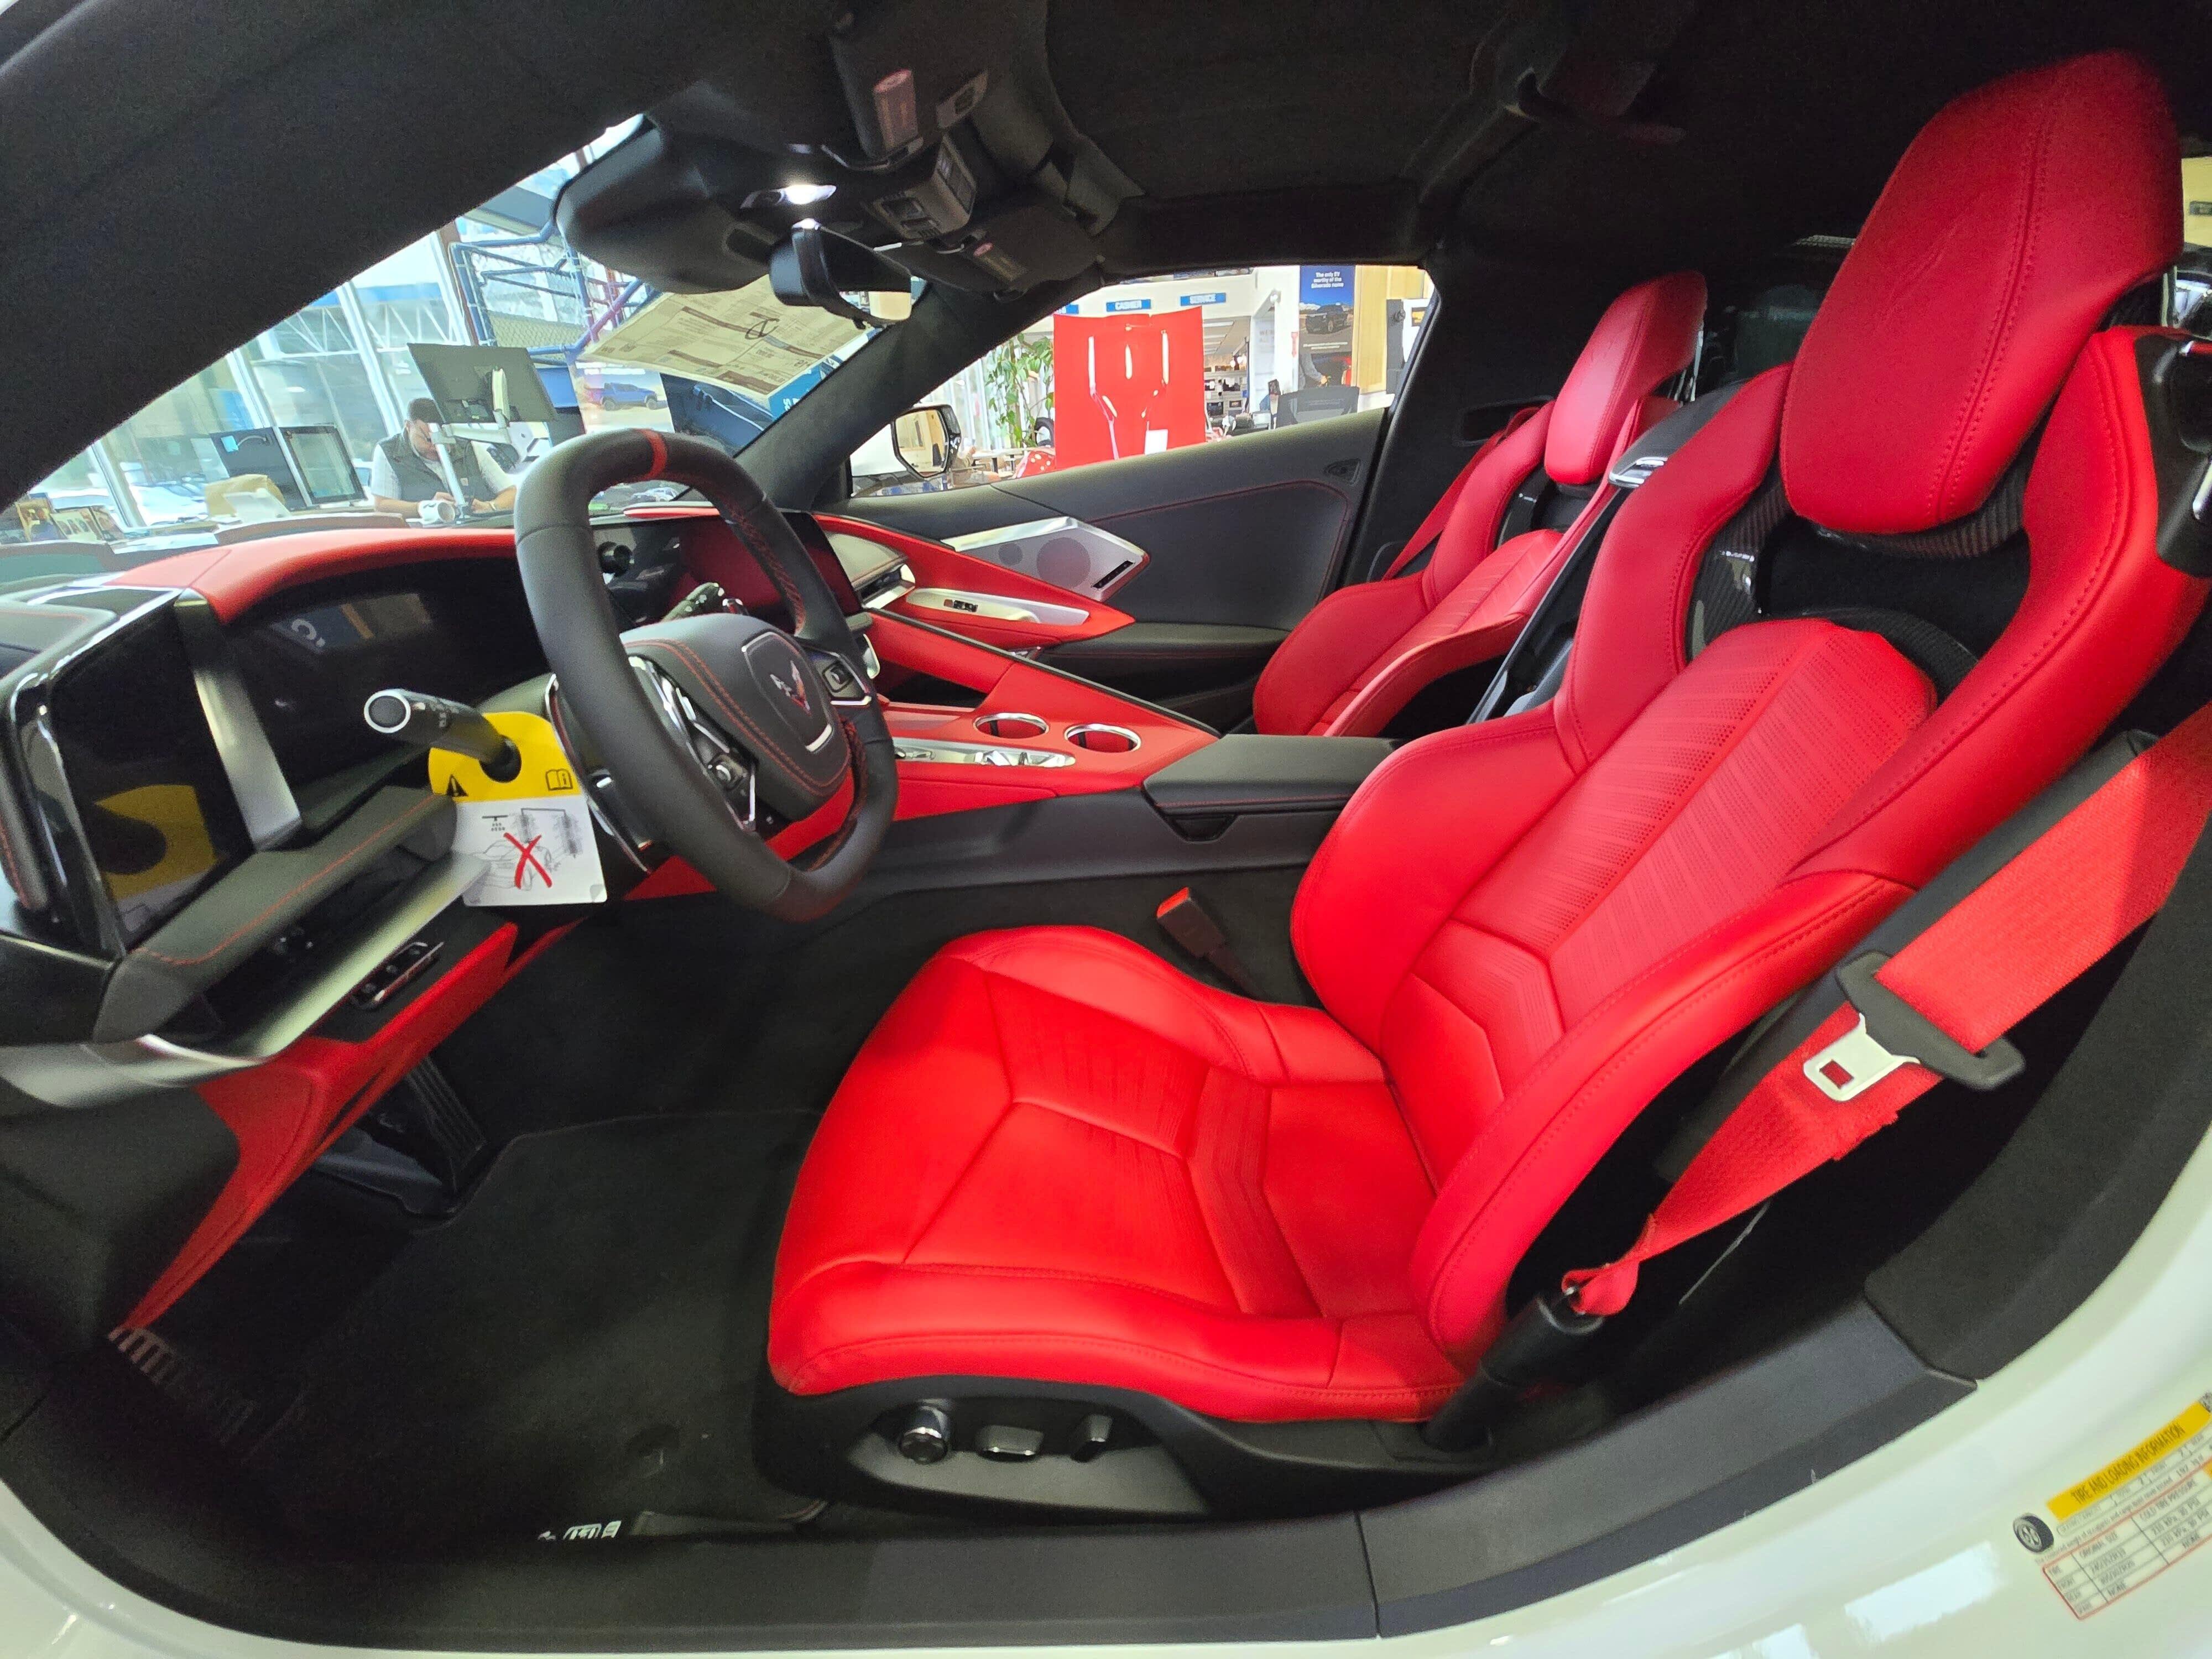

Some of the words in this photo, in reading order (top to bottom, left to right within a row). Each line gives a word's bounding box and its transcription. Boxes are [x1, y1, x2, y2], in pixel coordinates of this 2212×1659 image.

[2071, 1486, 2093, 1504] TIRE
[2089, 1478, 2107, 1496] AND
[2101, 1457, 2140, 1489] LOADING
[2135, 1422, 2185, 1464] INFORMATION
